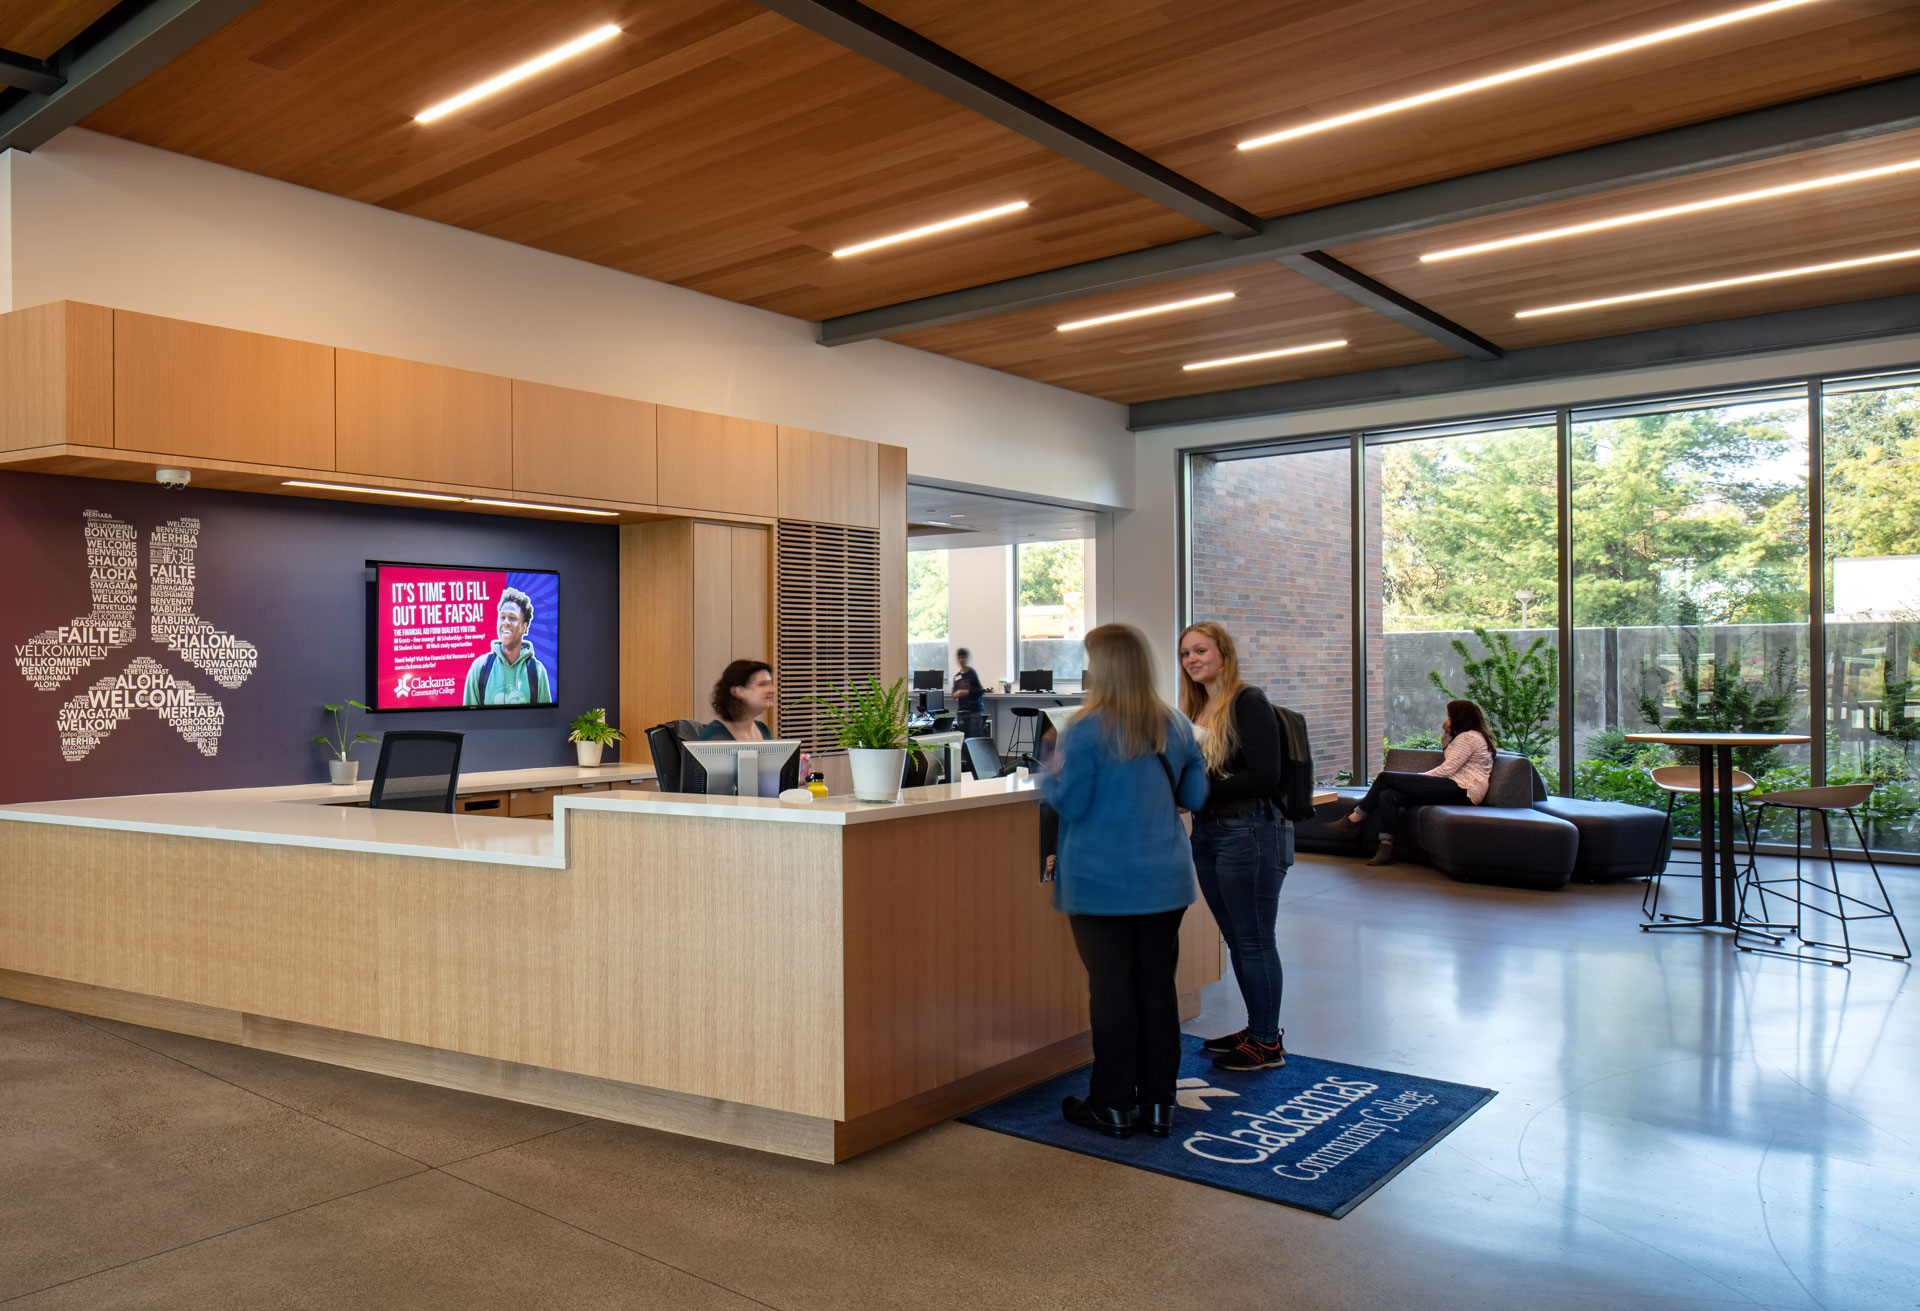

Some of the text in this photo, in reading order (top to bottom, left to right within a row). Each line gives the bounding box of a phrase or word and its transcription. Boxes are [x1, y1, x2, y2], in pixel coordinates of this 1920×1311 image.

[88, 522, 133, 530] WILLKOMMEN
[167, 520, 200, 529] WELCOME
[85, 528, 138, 540] BONVENU
[156, 526, 199, 535] BENVENUTO
[151, 532, 198, 544] MERHBA
[87, 540, 136, 550] WELCOME
[87, 548, 138, 557] BIENVENIDO
[162, 546, 194, 566] 歡迎
[88, 556, 138, 566] SHALOM
[90, 568, 136, 580] ALOHA
[150, 564, 196, 578] FAILTE
[90, 581, 138, 590] SWAGATAM
[152, 576, 192, 586] MERHABA
[392, 581, 490, 603] IT'S TIME TO FILL
[92, 594, 138, 604] WELKOM
[150, 605, 192, 614] MABUHAY
[392, 603, 484, 626] OUT THE FAFSA!
[72, 620, 132, 628] IRASSHAIMASE
[152, 616, 200, 625] MABUHAY
[58, 626, 120, 644] FAILTE
[151, 625, 215, 635] BENVENUTO
[402, 628, 422, 636] FINANCIAL
[168, 634, 234, 648] SHALOM
[15, 645, 108, 656] VELKOMMEN
[181, 648, 258, 660] BIENVENIDO
[15, 657, 90, 667] WILLKOMMEN
[194, 660, 257, 668] SUSWAGATAM
[22, 666, 79, 675] BENVENUTI
[115, 674, 177, 689] ALOHA
[410, 676, 455, 689] Clackamas
[88, 689, 196, 708] WELCOME
[60, 708, 129, 720] SWAGATAM
[158, 706, 225, 719] MERHABA
[57, 719, 117, 732] WELKOM
[169, 718, 224, 727] DOBRODOSLI
[62, 737, 100, 746] MERHBA
[1183, 1076, 1379, 1164] Clackamas
[1272, 1090, 1439, 1181] Community College
